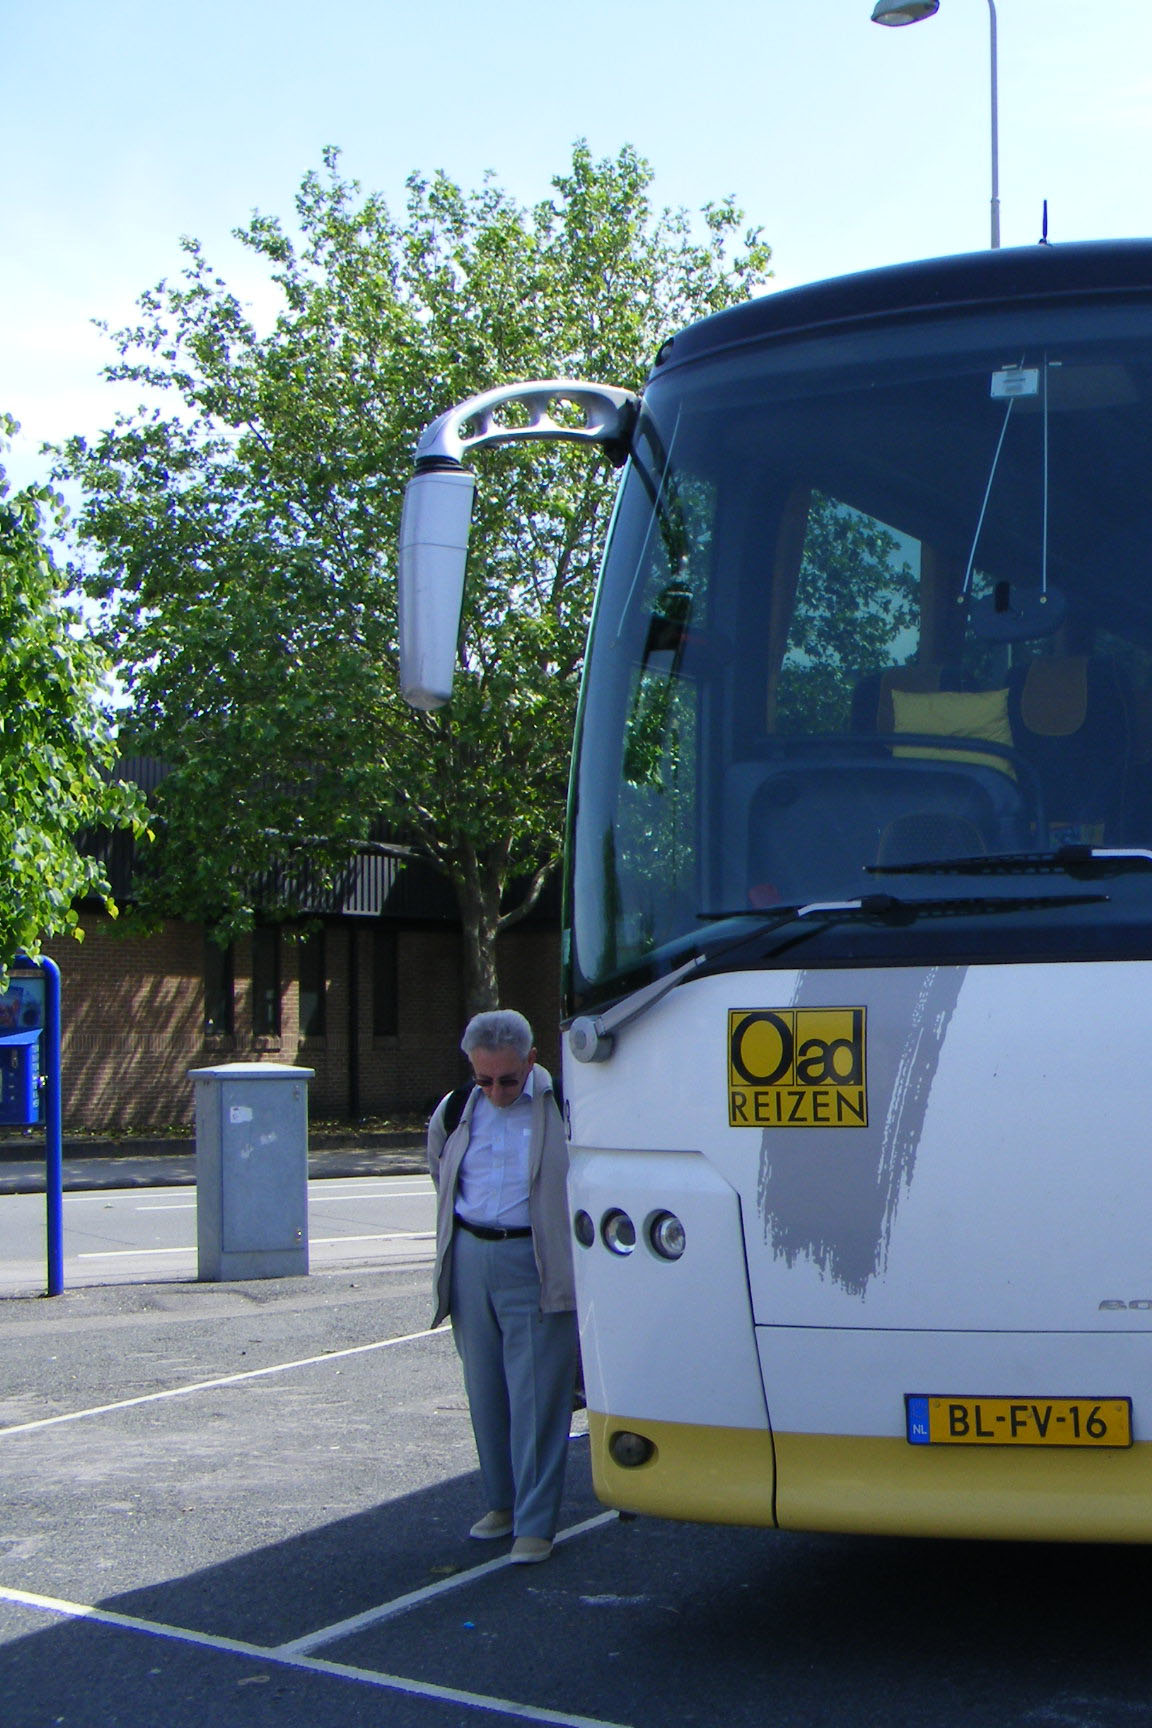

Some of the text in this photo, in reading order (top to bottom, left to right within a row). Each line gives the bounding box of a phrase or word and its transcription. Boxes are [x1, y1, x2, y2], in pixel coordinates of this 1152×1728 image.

[732, 1010, 863, 1086] Oad
[731, 1090, 865, 1122] REIZEN
[912, 1423, 928, 1435] NL
[949, 1404, 1107, 1439] BL-FV-16
